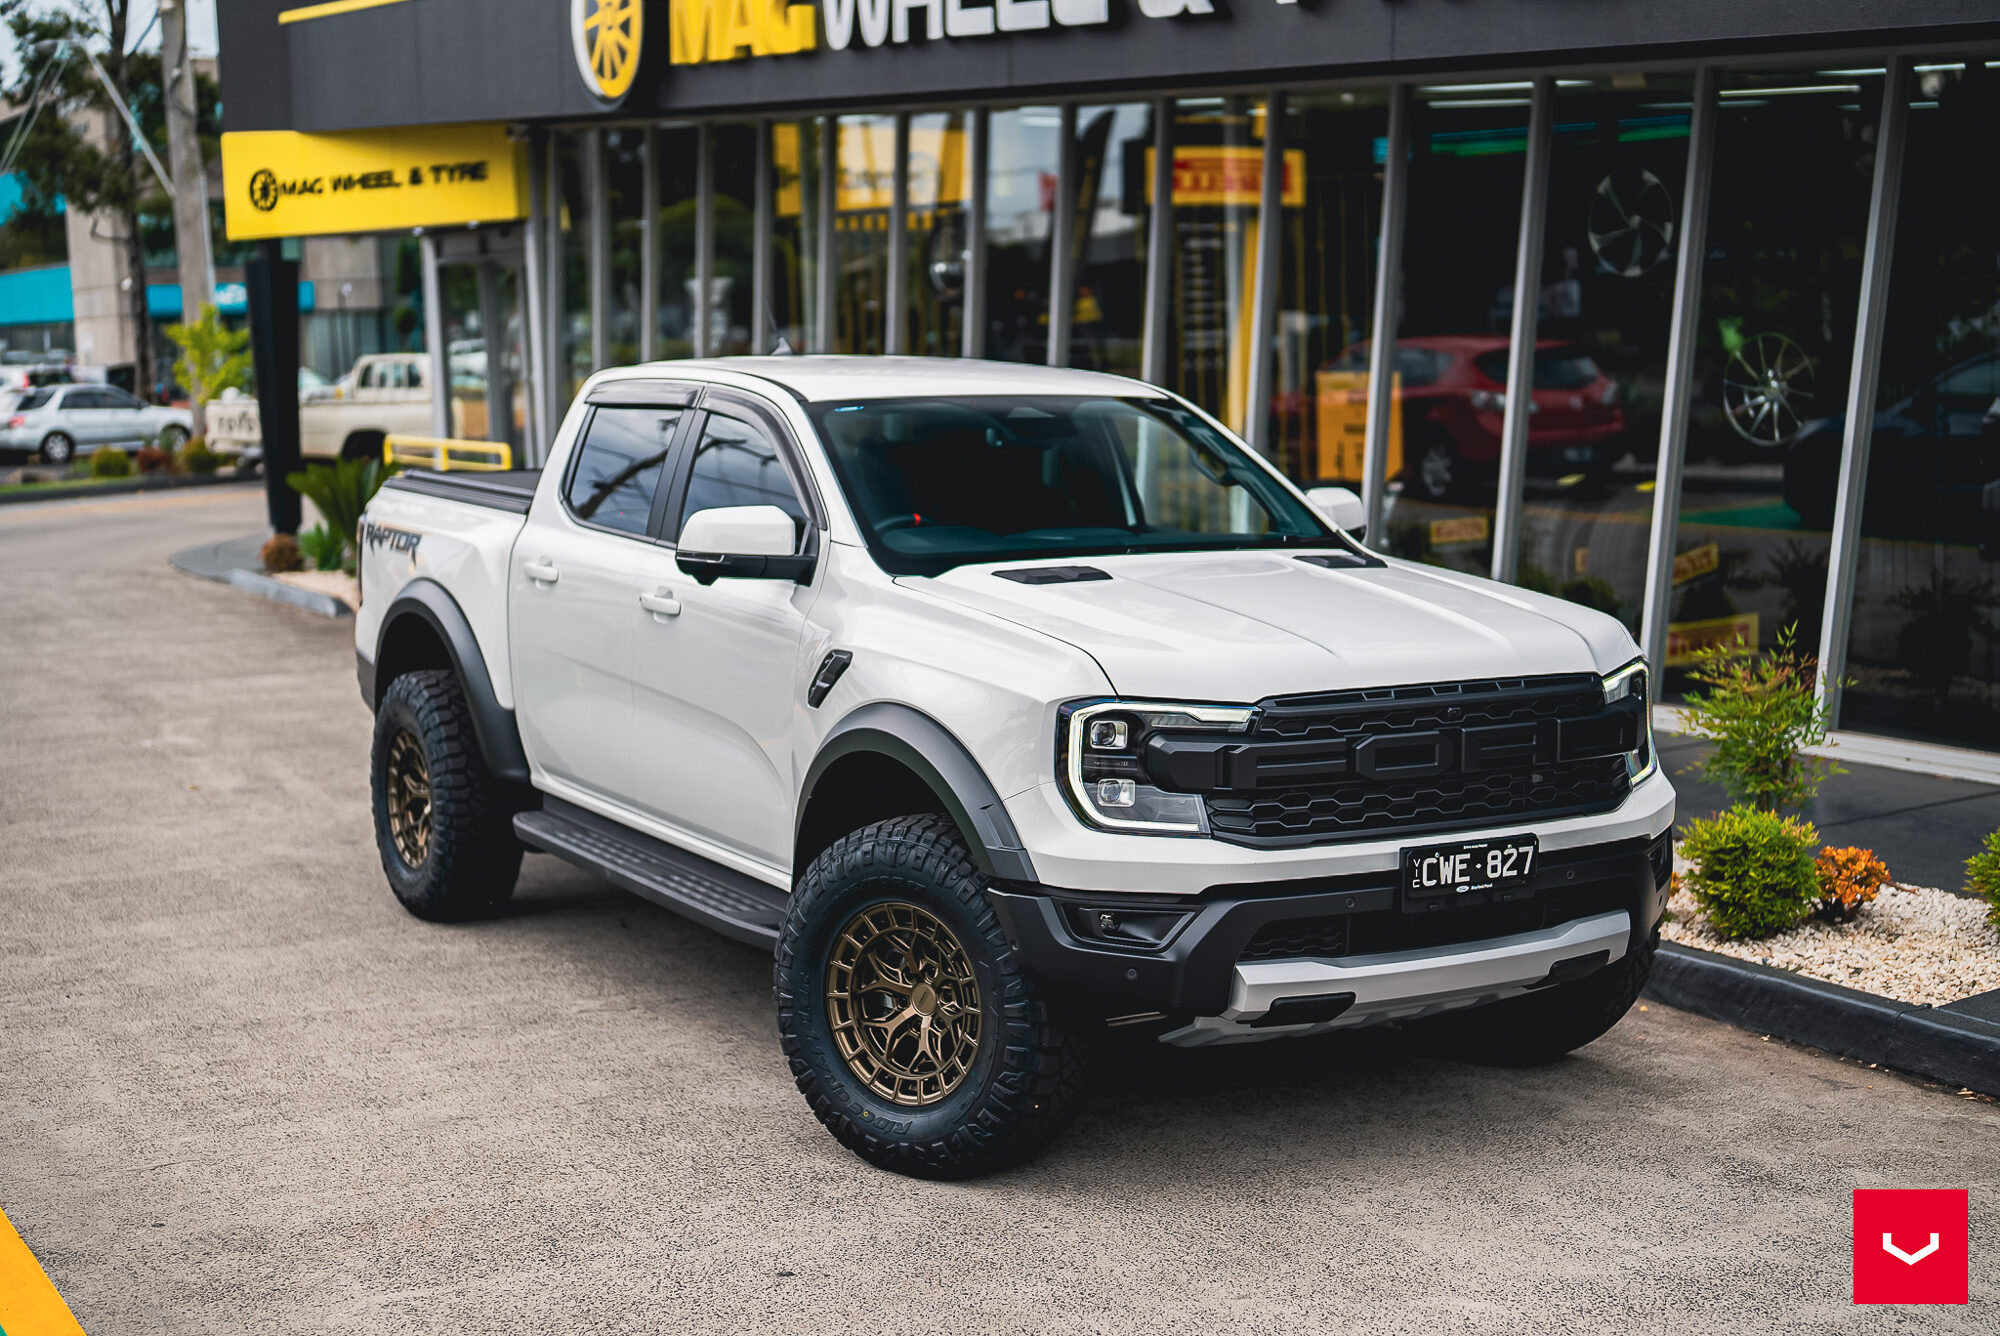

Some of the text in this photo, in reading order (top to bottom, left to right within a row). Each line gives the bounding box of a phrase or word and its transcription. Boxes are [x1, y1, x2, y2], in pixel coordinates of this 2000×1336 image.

[332, 169, 402, 192] WHEEL
[428, 160, 489, 184] TYRE
[366, 522, 422, 569] RAPTOR
[1422, 845, 1534, 887] CWE 827
